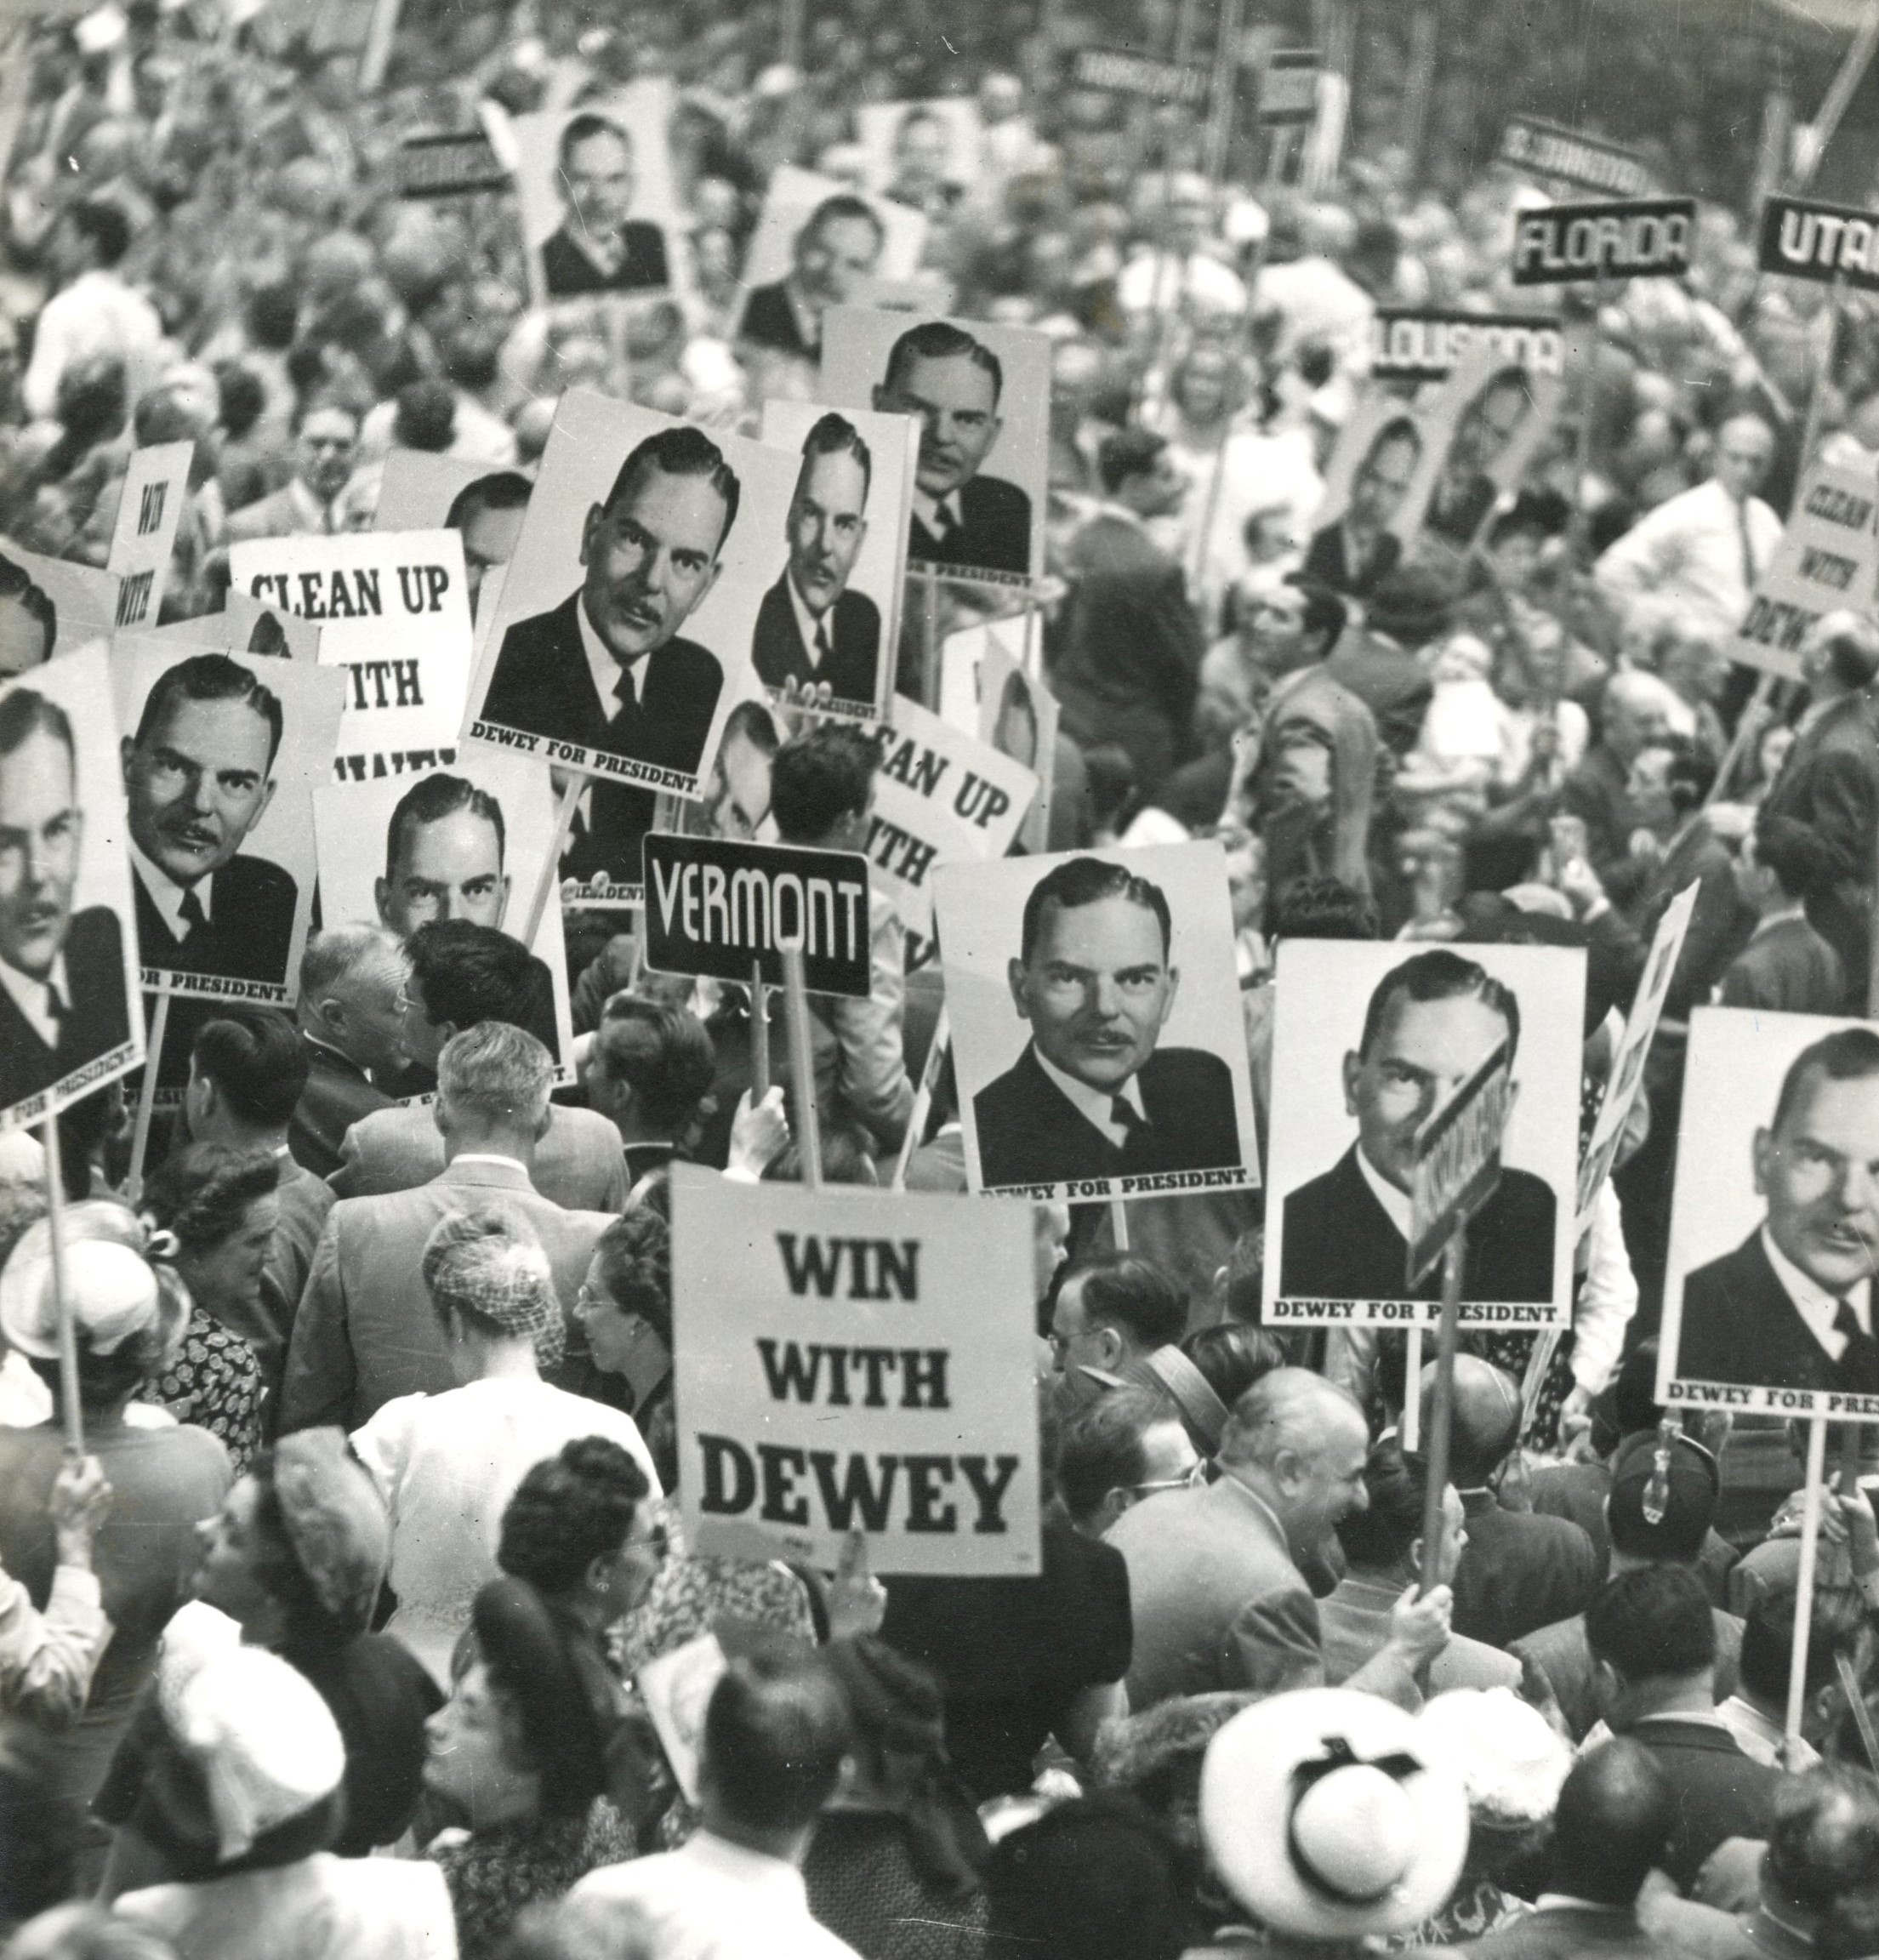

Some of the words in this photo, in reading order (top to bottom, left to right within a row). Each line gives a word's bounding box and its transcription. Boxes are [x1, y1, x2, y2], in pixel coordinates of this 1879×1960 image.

[1517, 214, 1688, 270] FLORIDA
[1779, 208, 1879, 274] UTA
[251, 569, 383, 620] CLEAN
[396, 565, 449, 614] UP
[344, 659, 424, 709] ITH
[470, 722, 539, 751] DEWEY
[545, 741, 587, 765] FOR
[593, 754, 698, 793] PRESIDENT
[953, 770, 1010, 829] UP
[864, 815, 938, 886] ITH
[652, 858, 863, 961] VERMONT
[171, 972, 288, 1001] PRESIDENT
[1066, 1180, 1112, 1197] FOR
[1121, 1168, 1247, 1194] PRESIDENT
[775, 1230, 921, 1302] WIN
[1273, 1301, 1356, 1319] DEWEY
[1367, 1302, 1415, 1319] FOR
[1427, 1304, 1558, 1322] PESIDENT
[755, 1337, 951, 1410] WITH
[1668, 1382, 1752, 1404] DEWEY
[1766, 1390, 1814, 1410] FOR
[697, 1433, 1019, 1534] DEWEY
